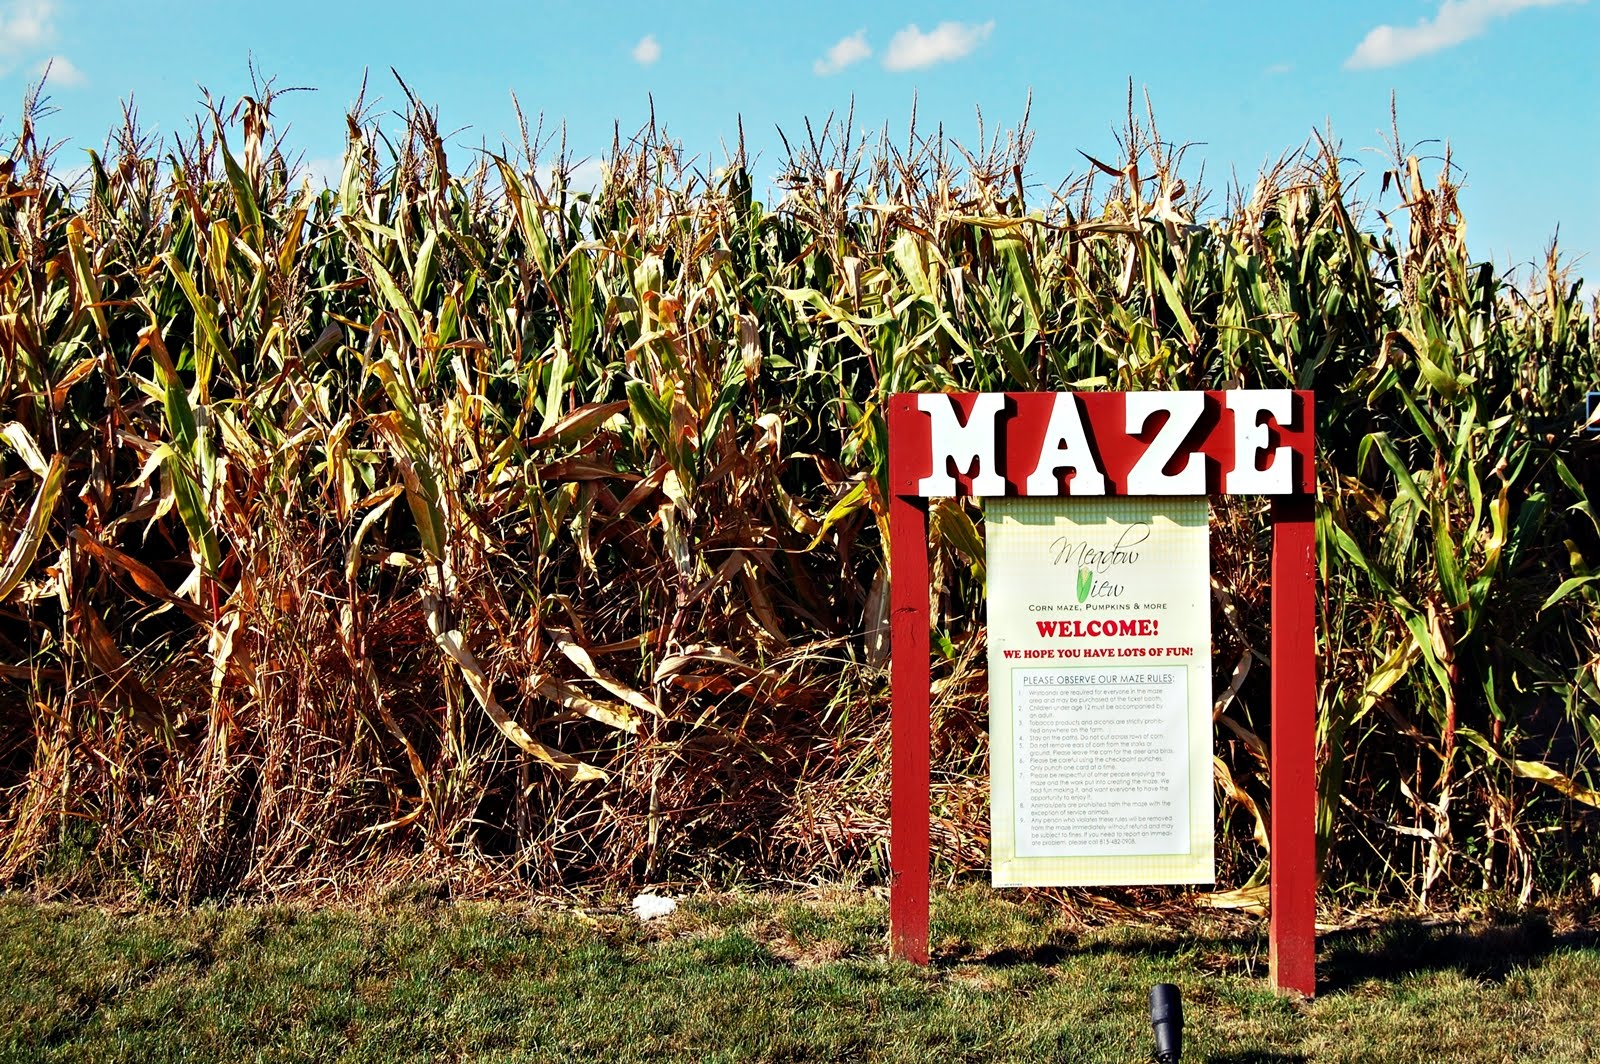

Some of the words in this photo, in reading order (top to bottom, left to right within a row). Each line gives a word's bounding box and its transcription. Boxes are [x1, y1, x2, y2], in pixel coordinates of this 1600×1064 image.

[918, 389, 1292, 497] MAZE
[1049, 522, 1150, 573] Meadow
[1036, 620, 1159, 638] WELCOME!
[1003, 650, 1021, 659] WE
[1024, 650, 1055, 659] HOPE
[1058, 650, 1081, 658] YOU
[1084, 649, 1115, 658] HAVE
[1118, 649, 1146, 657] LOTS
[1149, 648, 1163, 657] OF
[1166, 647, 1193, 656] FUN!
[1057, 676, 1095, 684] OBSERVE
[1099, 675, 1117, 683] OUR
[1121, 675, 1144, 683] MAZE
[1148, 674, 1175, 683] RULES:
